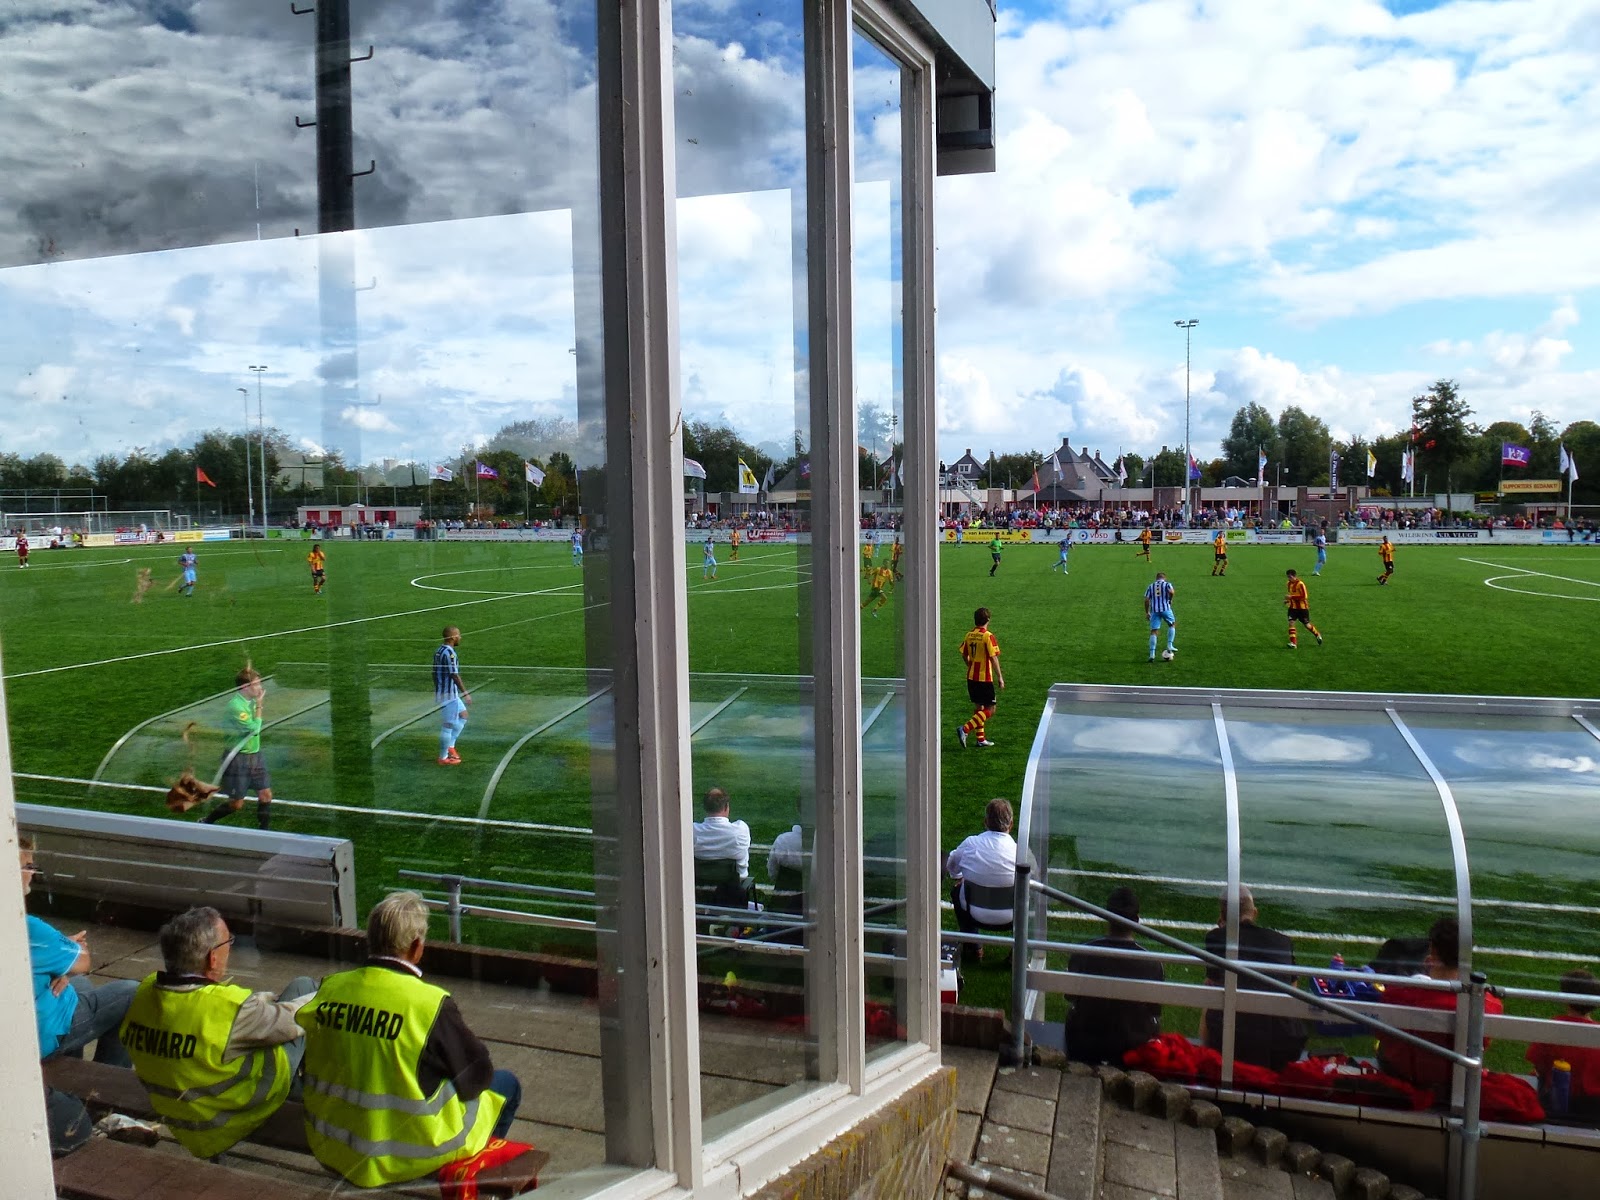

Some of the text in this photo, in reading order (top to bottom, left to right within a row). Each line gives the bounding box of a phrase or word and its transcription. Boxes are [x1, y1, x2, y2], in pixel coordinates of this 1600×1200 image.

[969, 641, 977, 658] 11
[121, 1020, 197, 1060] STEWARD
[315, 1001, 404, 1041] STEWARD
